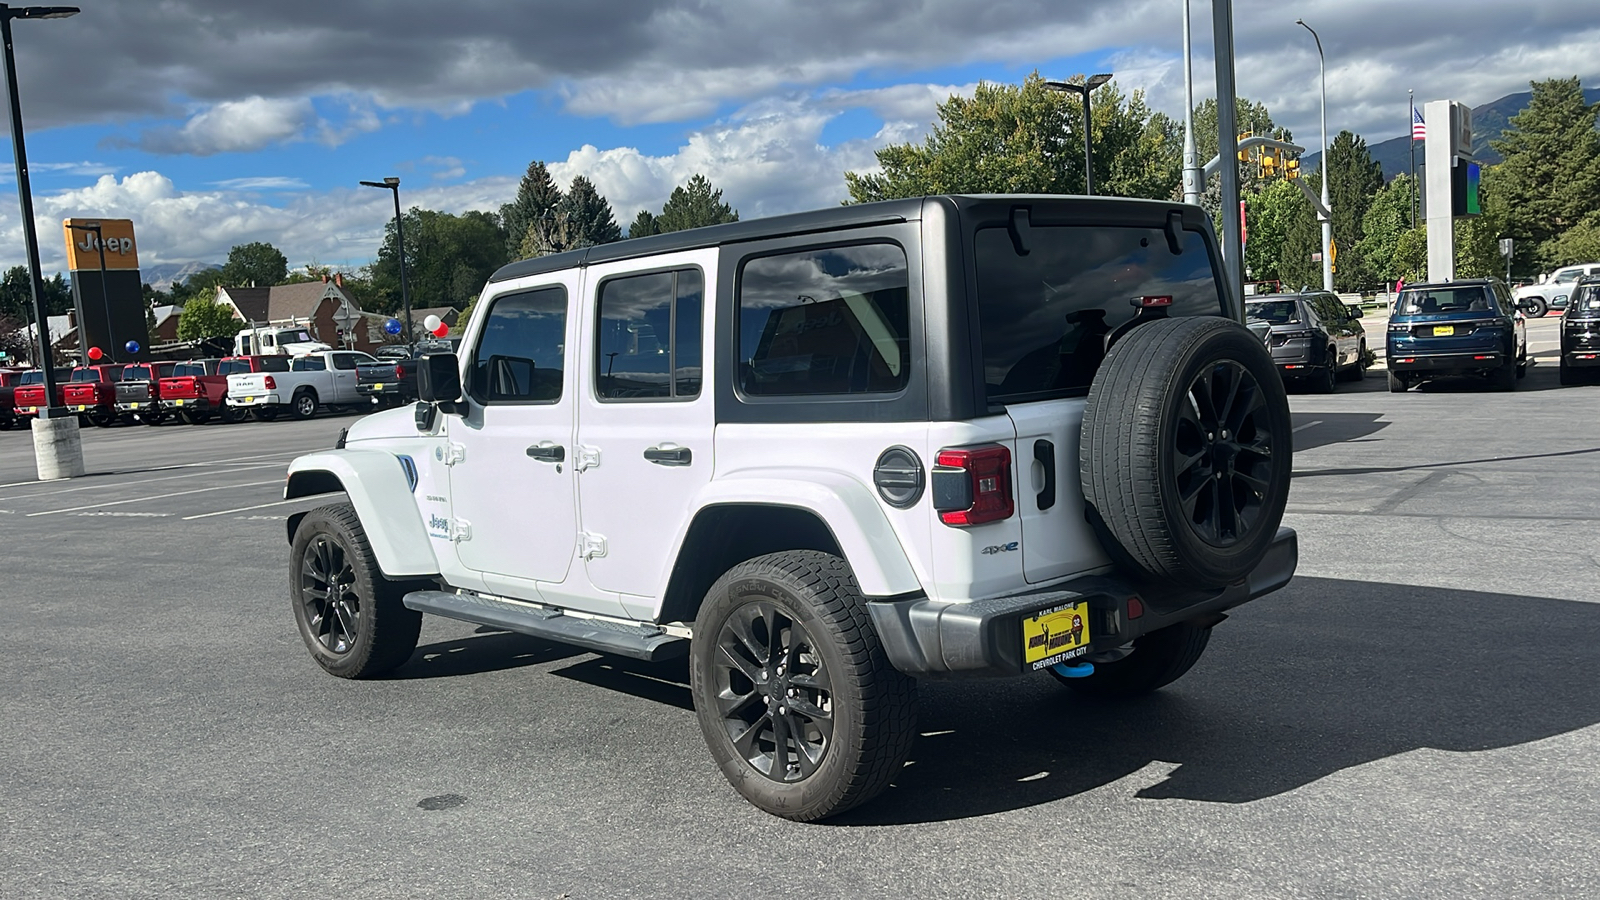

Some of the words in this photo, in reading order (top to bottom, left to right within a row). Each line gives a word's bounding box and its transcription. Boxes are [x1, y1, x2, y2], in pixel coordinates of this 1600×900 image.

[78, 233, 133, 256] Jeep
[429, 513, 448, 533] Jeep
[1038, 608, 1052, 617] KARL
[1054, 602, 1074, 612] MALONE
[1073, 618, 1081, 627] 32
[1032, 655, 1062, 671] CHEVROLET
[1062, 651, 1076, 661] PARK
[1076, 646, 1087, 657] CITY
